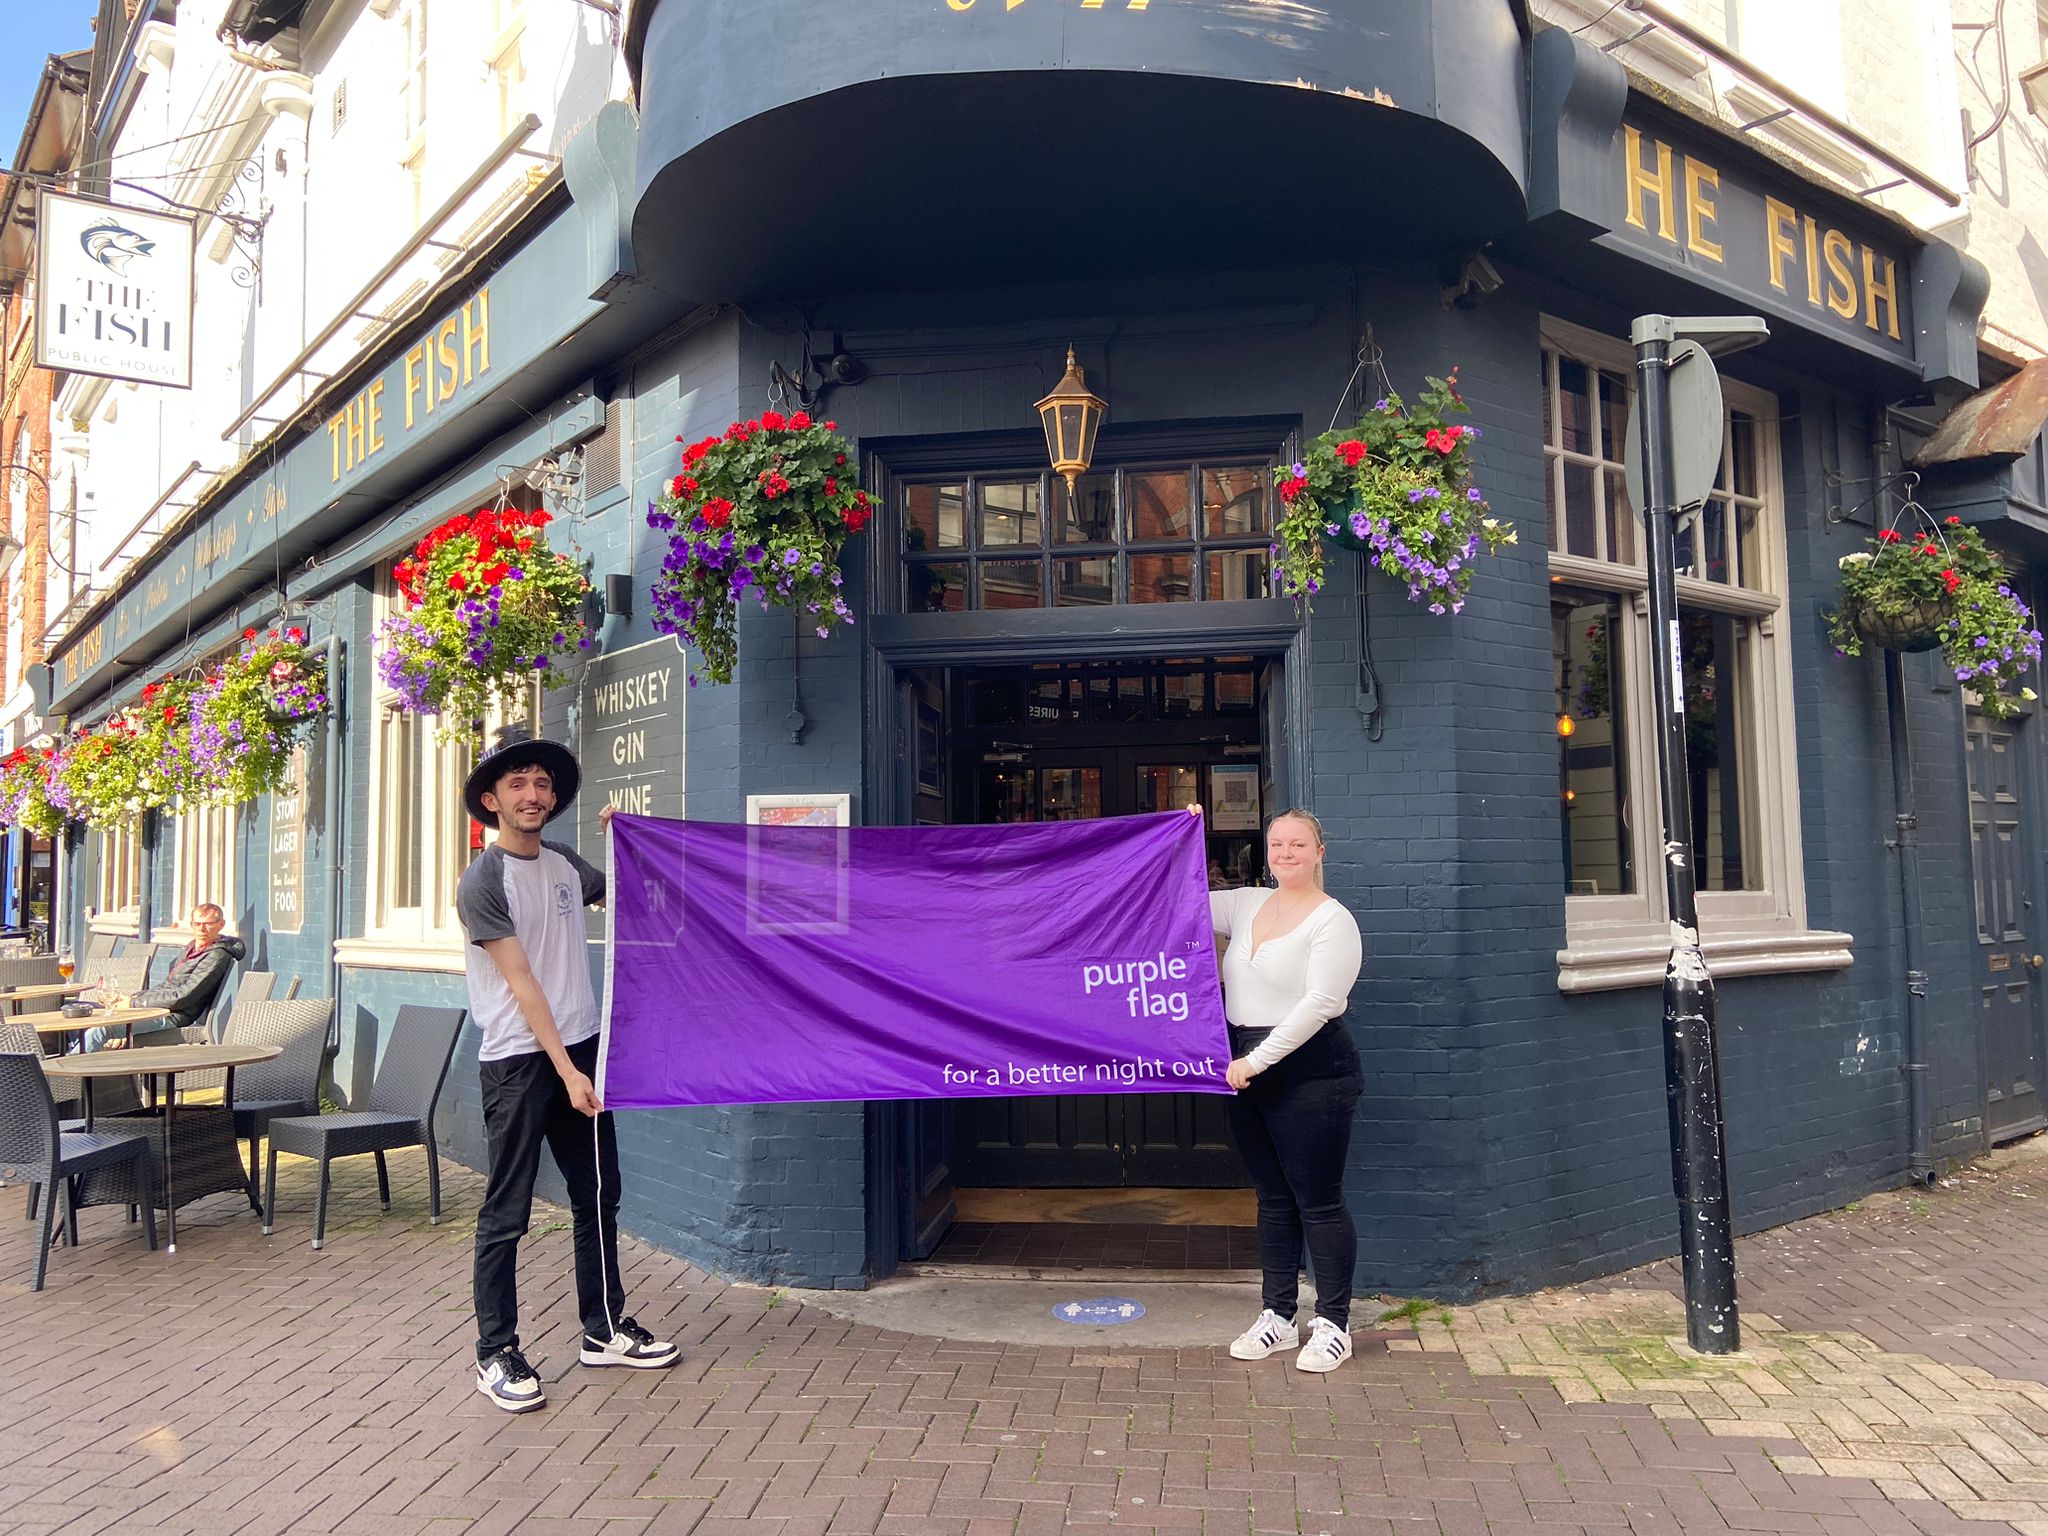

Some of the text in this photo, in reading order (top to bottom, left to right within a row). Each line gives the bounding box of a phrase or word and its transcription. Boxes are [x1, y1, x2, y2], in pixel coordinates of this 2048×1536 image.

[1623, 123, 1902, 342] HE FISH
[77, 277, 157, 312] THE
[59, 303, 171, 352] FISH
[48, 347, 111, 368] PUBLIC
[327, 288, 491, 483] THE FISH
[594, 667, 671, 718] WHISKEY
[612, 729, 645, 766] GIN
[276, 798, 300, 821] STOUT
[608, 784, 652, 817] WINE
[274, 831, 299, 853] LAGER
[274, 891, 297, 912] FOOD
[1083, 952, 1187, 993] purple
[1127, 987, 1189, 1021] flag
[942, 1055, 1218, 1086] for a better night out
